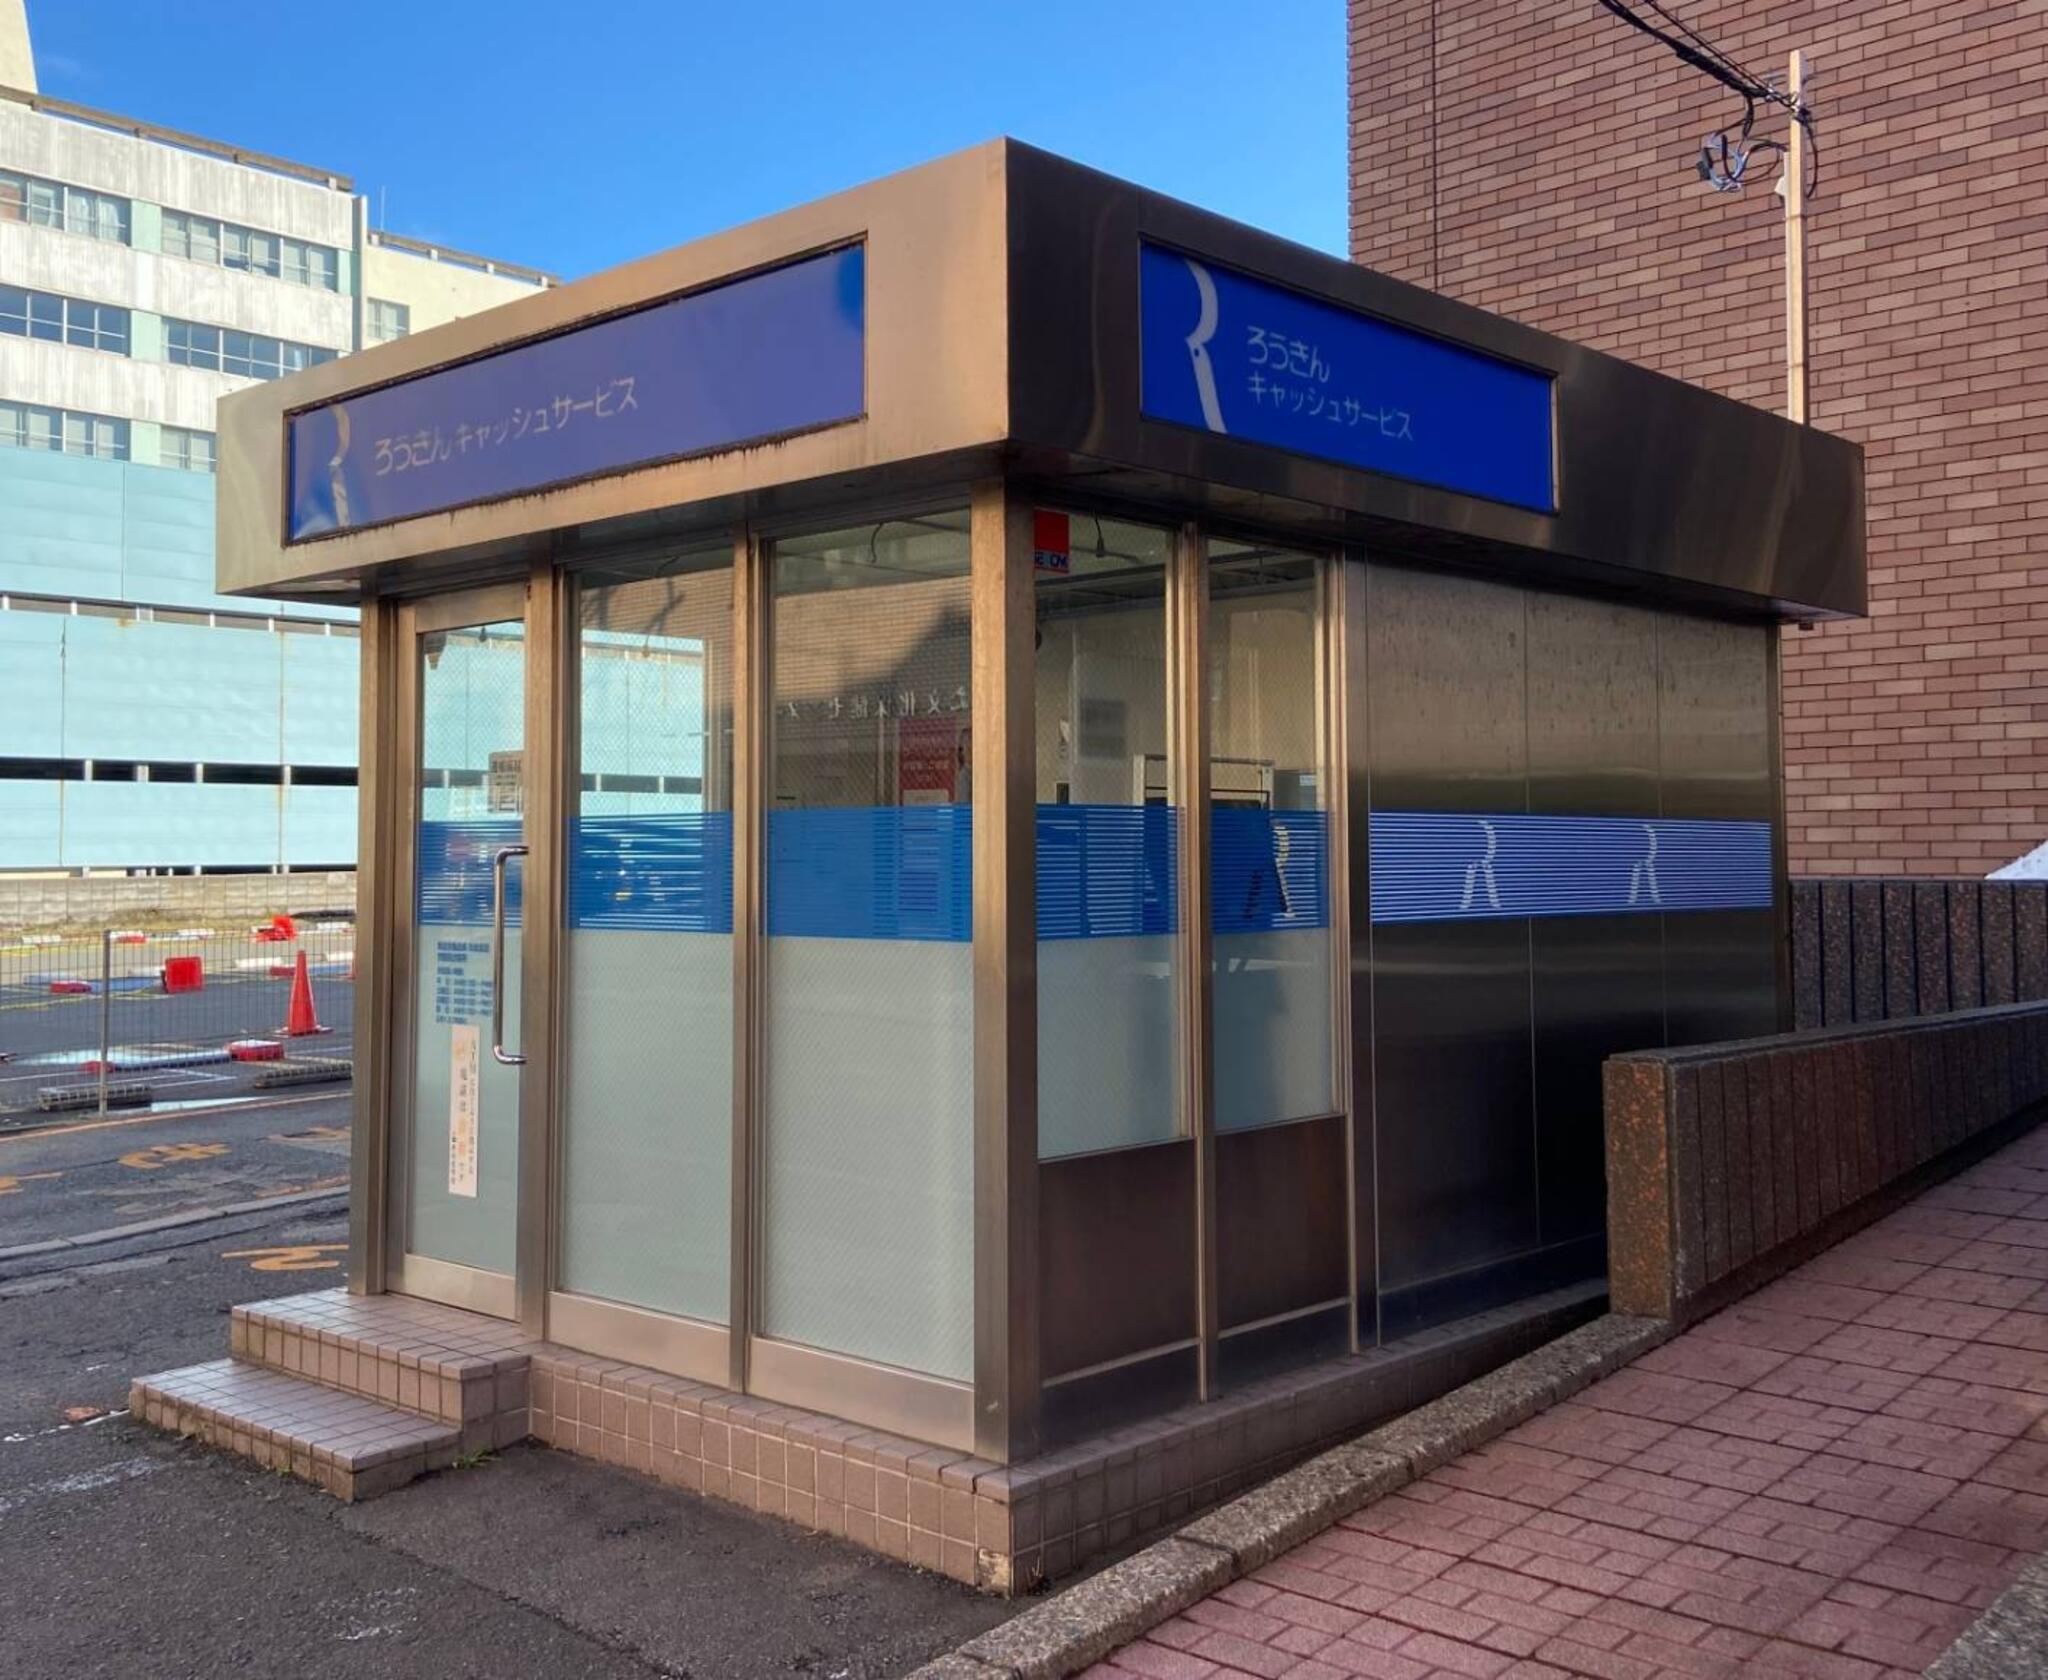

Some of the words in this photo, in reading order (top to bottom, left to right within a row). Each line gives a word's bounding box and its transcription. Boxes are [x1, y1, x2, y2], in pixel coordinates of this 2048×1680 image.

[1246, 324, 1331, 384] ろうきん
[1247, 369, 1415, 442] キャッシュサービス
